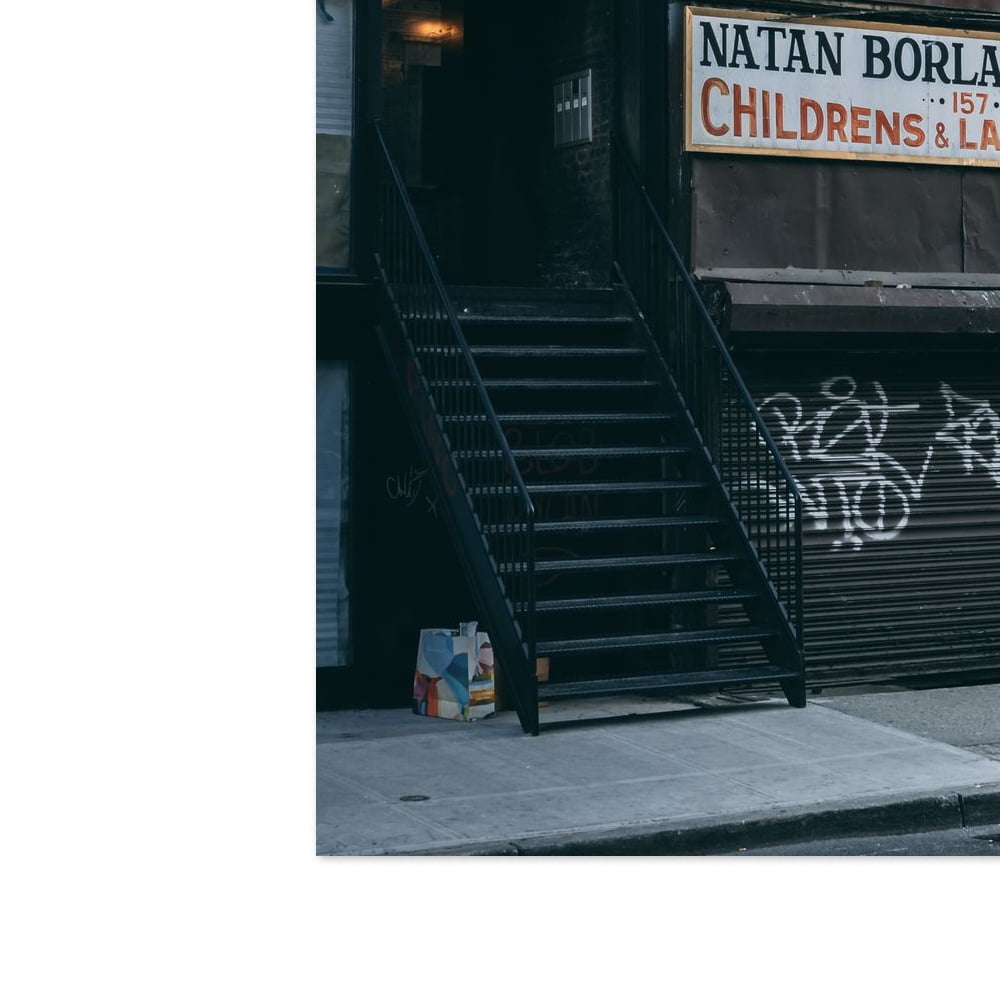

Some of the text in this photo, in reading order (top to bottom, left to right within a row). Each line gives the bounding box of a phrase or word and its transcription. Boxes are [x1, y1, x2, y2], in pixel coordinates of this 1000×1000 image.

[699, 21, 844, 76] NATAN
[700, 76, 926, 148] CHILDRENS
[934, 121, 950, 149] &
